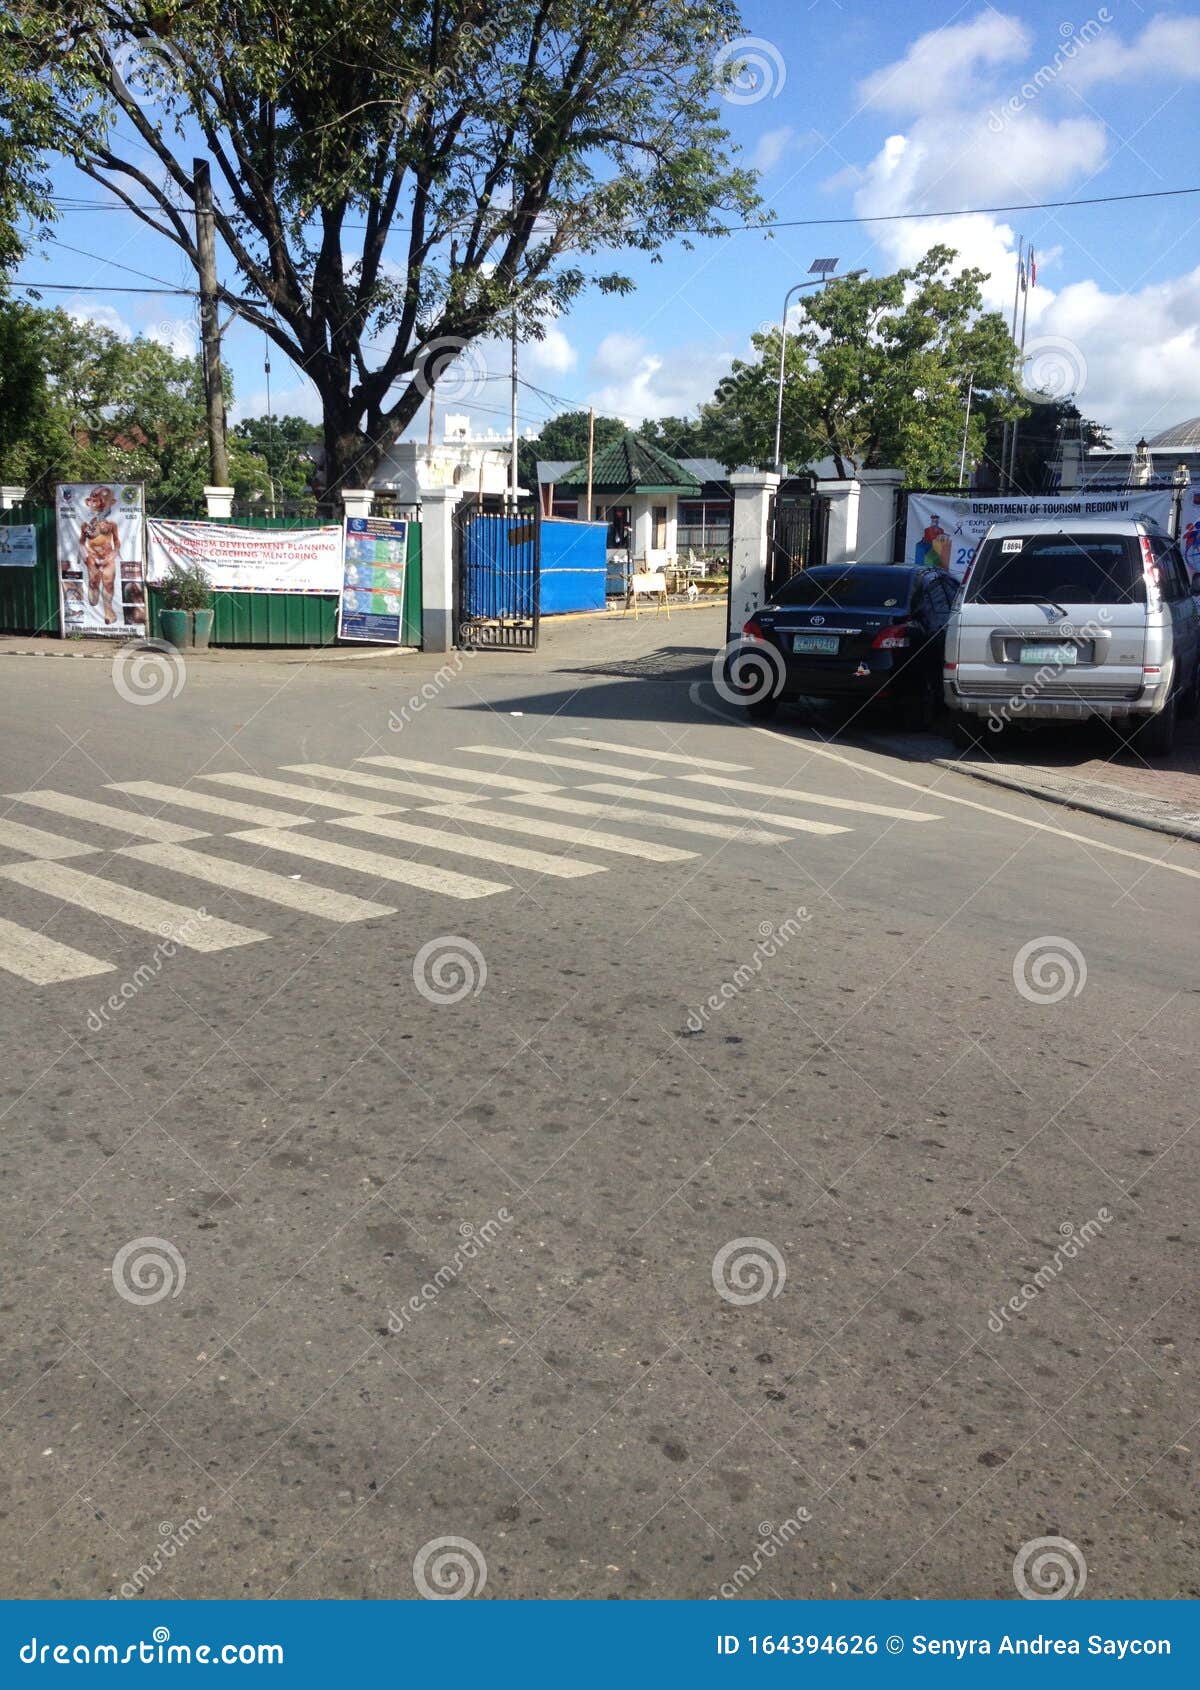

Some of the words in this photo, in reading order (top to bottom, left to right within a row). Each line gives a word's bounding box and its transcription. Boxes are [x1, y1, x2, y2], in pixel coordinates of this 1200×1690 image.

[972, 503, 1028, 514] DEPARTMENT
[1030, 503, 1041, 514] OF
[1043, 503, 1081, 513] TOURISM
[1085, 502, 1118, 512] REGION
[1119, 501, 1129, 511] VI
[180, 538, 217, 548] TOURISM
[219, 540, 285, 551] DEVELOPMENT
[287, 542, 337, 552] PLANNING
[209, 549, 258, 558] COACHING
